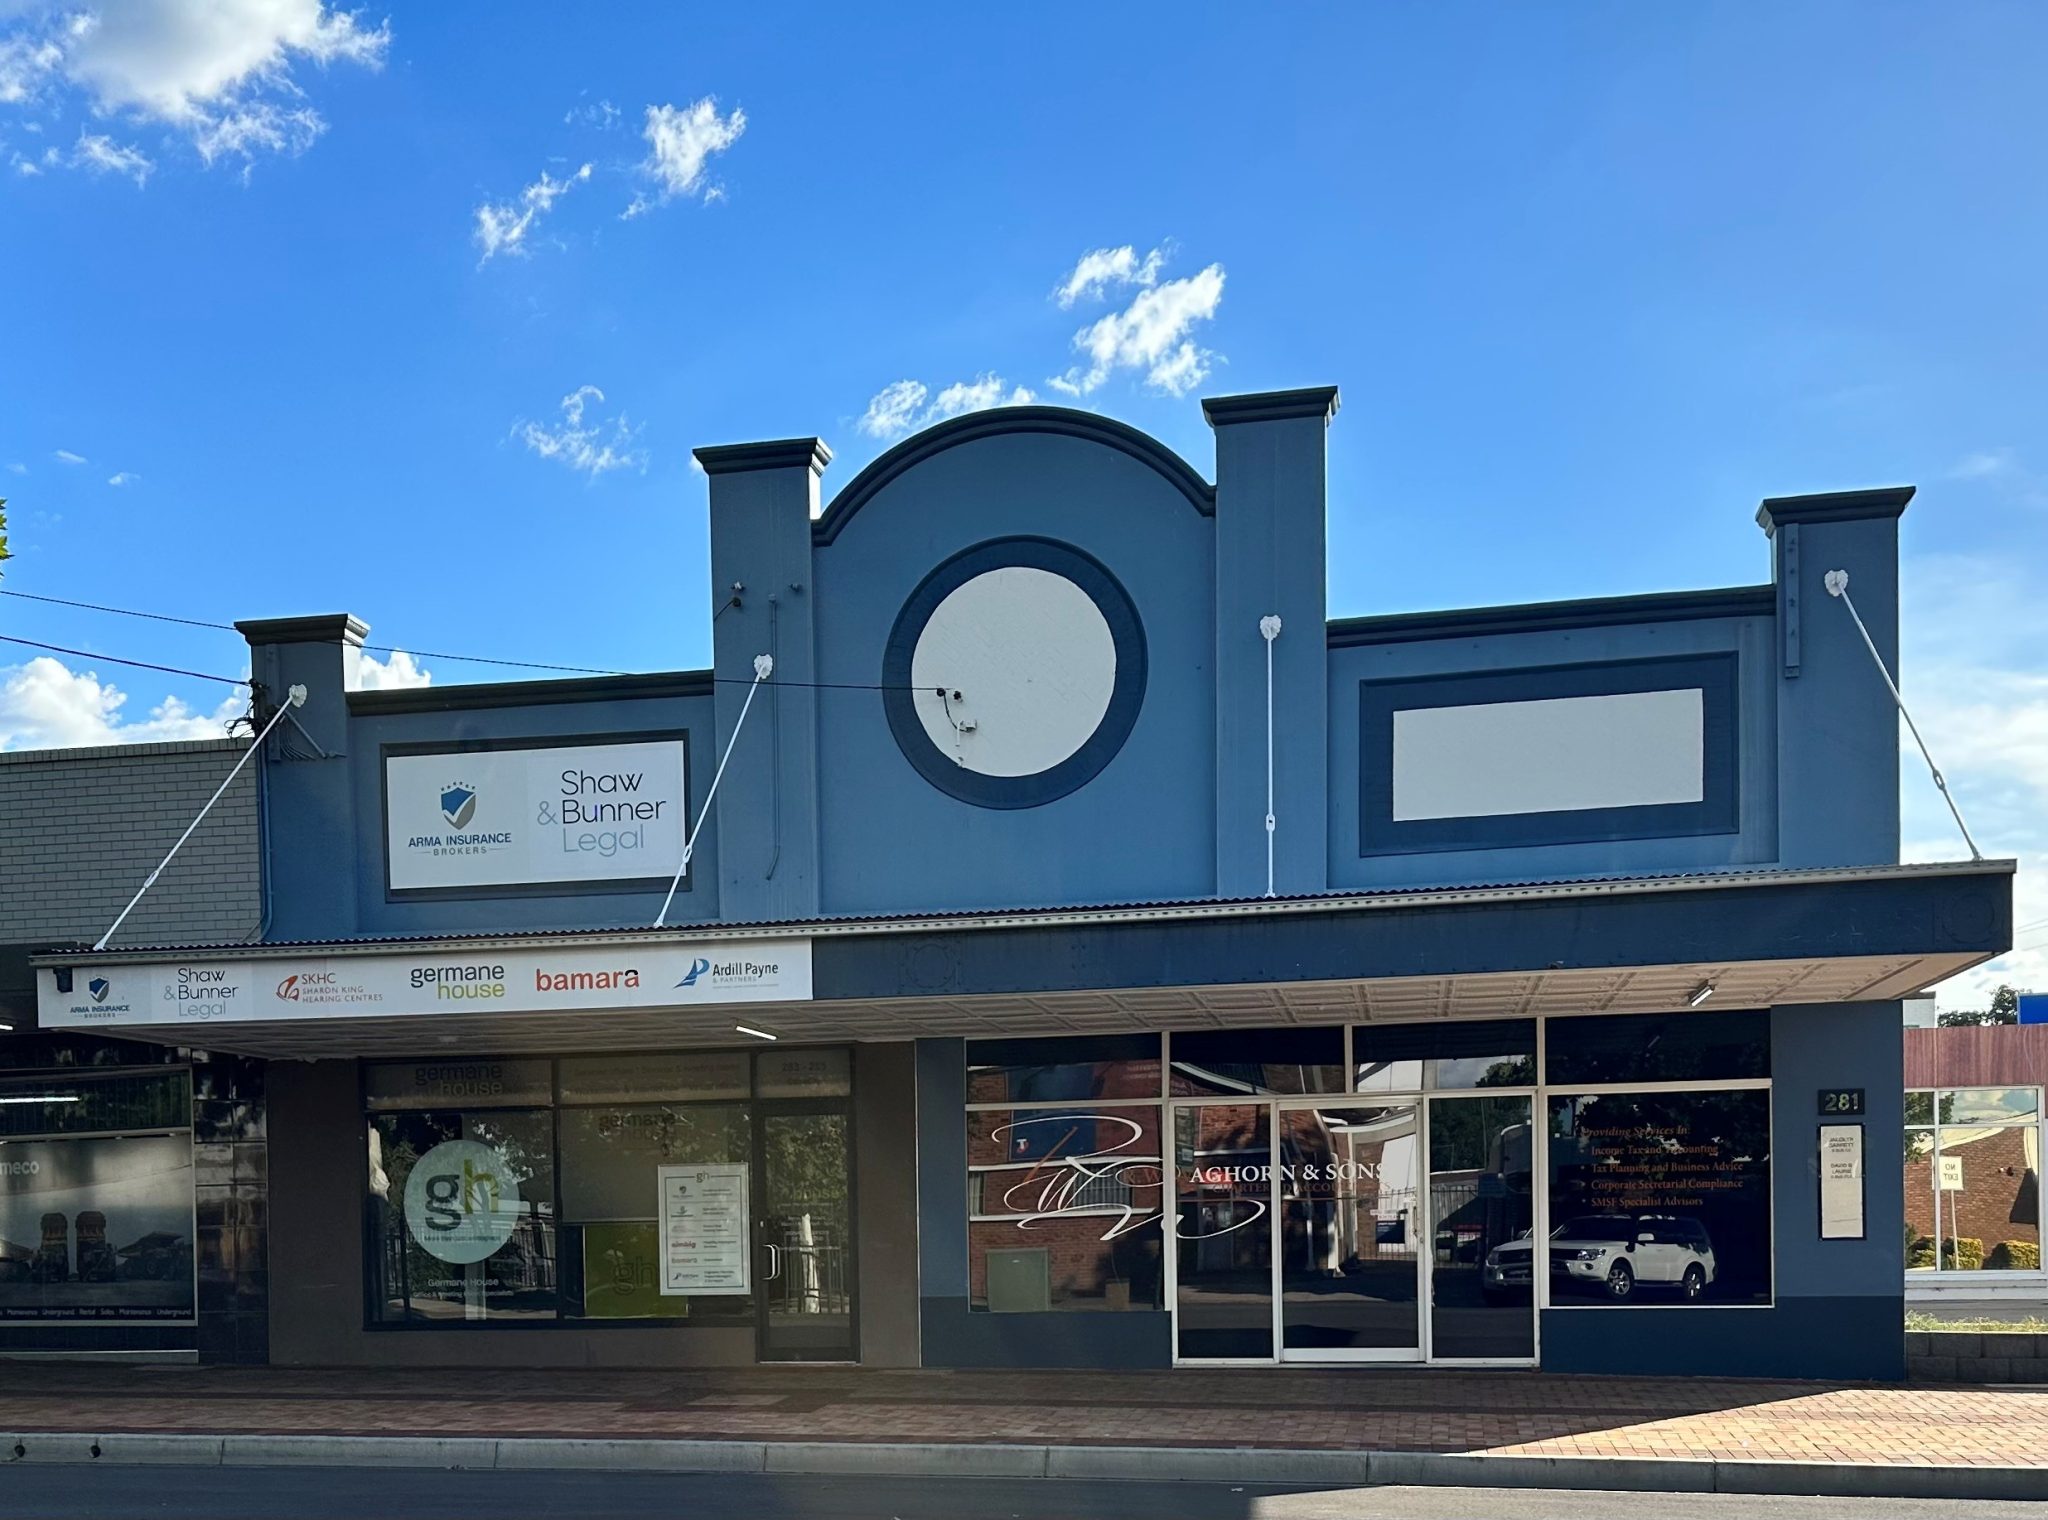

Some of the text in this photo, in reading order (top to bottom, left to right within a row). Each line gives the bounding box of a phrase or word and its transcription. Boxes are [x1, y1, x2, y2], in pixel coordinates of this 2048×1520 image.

[560, 769, 643, 795] Shaw
[536, 798, 667, 826] & Bunner
[408, 832, 512, 848] ARMA INSURANCE
[562, 824, 644, 857] Legal
[433, 846, 488, 857] BROKERS
[178, 967, 225, 983] Shaw
[410, 963, 505, 988] germane
[712, 962, 779, 978] Ardill Payne
[301, 972, 337, 985] SKHC
[536, 968, 640, 992] bamara
[163, 984, 239, 1001] & Bunner
[302, 985, 364, 995] SHARON KING
[437, 979, 505, 1000] house
[302, 993, 384, 1003] HEARING CENTRES
[70, 1004, 131, 1014] ARMA INSURANCE
[179, 1000, 226, 1019] Legal
[415, 1064, 503, 1086] germane
[439, 1080, 504, 1097] house
[1824, 1093, 1859, 1111] 281
[1176, 1165, 1297, 1183] AGHORN
[1302, 1164, 1321, 1181] &
[1591, 1160, 1744, 1175] Tax Planning and Business Advice
[696, 1171, 710, 1183] gh
[1591, 1177, 1744, 1192] Corporate Secretarial Compliance
[425, 1159, 499, 1232] gh
[1212, 1182, 1292, 1193] CHARTERD
[1591, 1195, 1704, 1208] SMSF Specialist Advisors
[470, 1278, 499, 1286] House
